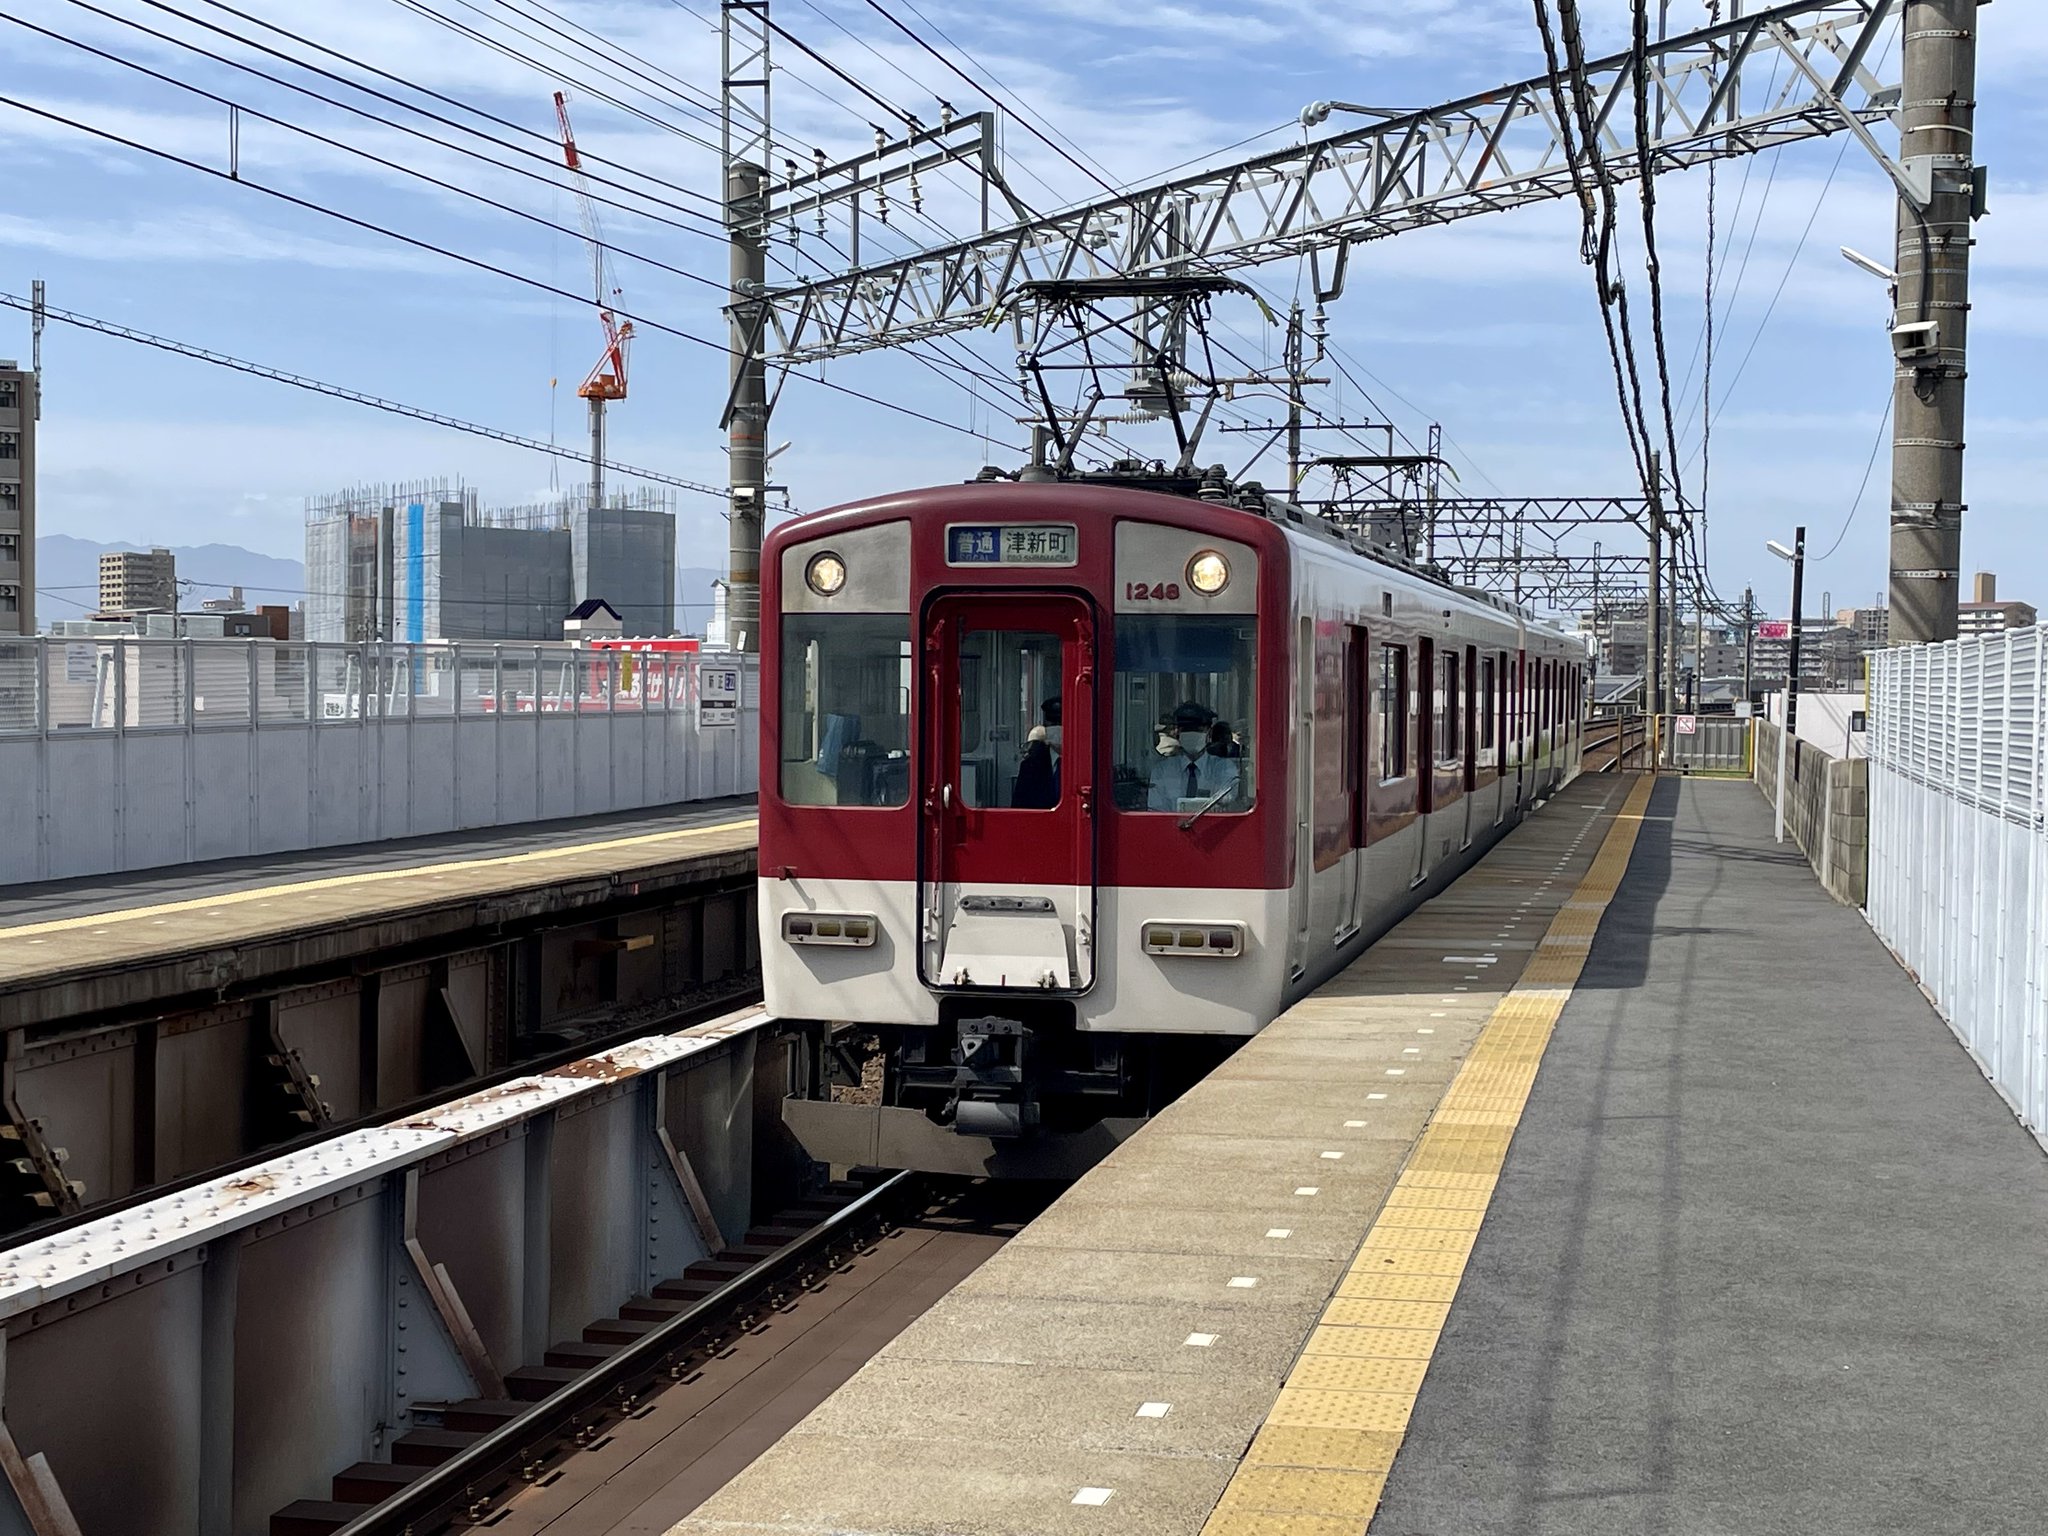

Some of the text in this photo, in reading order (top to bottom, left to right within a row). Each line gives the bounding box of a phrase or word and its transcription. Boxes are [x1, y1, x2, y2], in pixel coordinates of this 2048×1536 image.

[957, 531, 994, 554] 普通
[1006, 531, 1068, 554] 津新町
